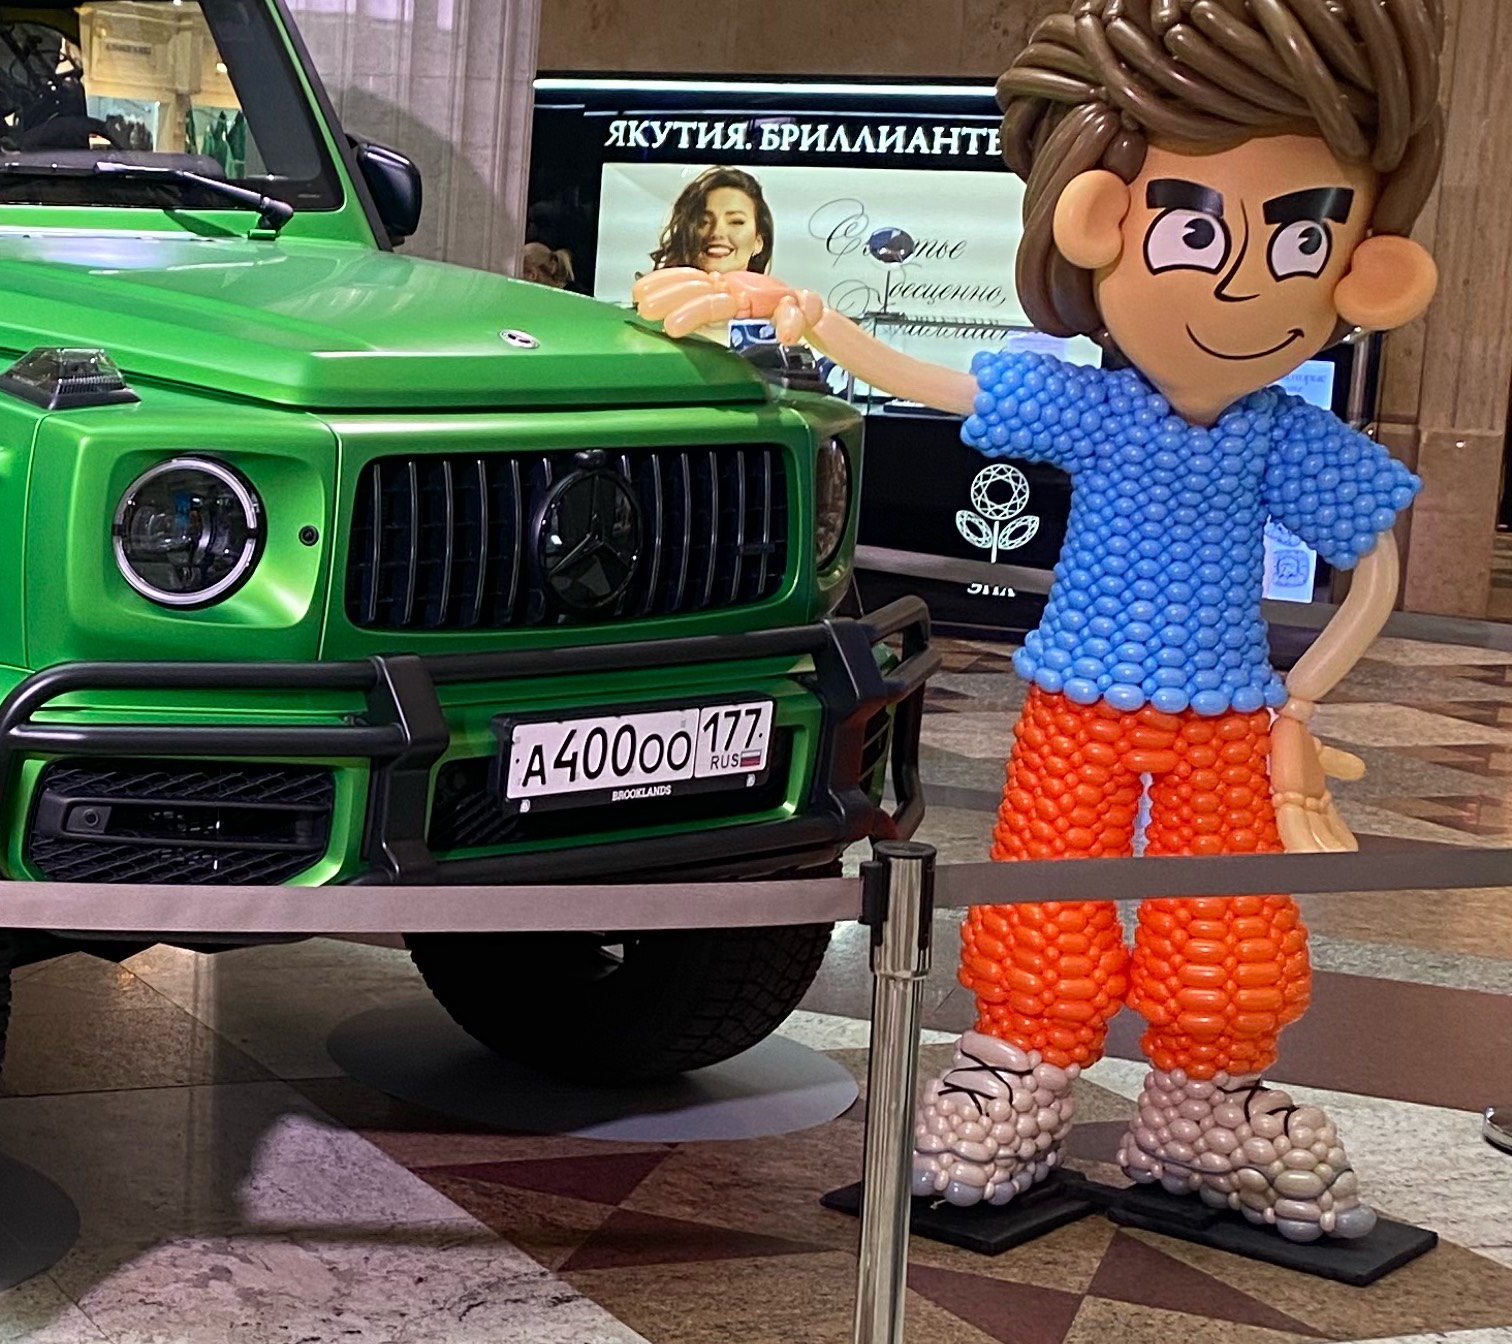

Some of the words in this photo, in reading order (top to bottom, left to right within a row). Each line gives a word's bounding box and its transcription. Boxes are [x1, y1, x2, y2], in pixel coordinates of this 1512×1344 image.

[604, 120, 752, 151] ЯКУТИЯ.
[808, 198, 967, 268] Стье
[703, 708, 762, 753] 177
[710, 753, 739, 770] RUS
[611, 785, 672, 802] BROOKLANDS
